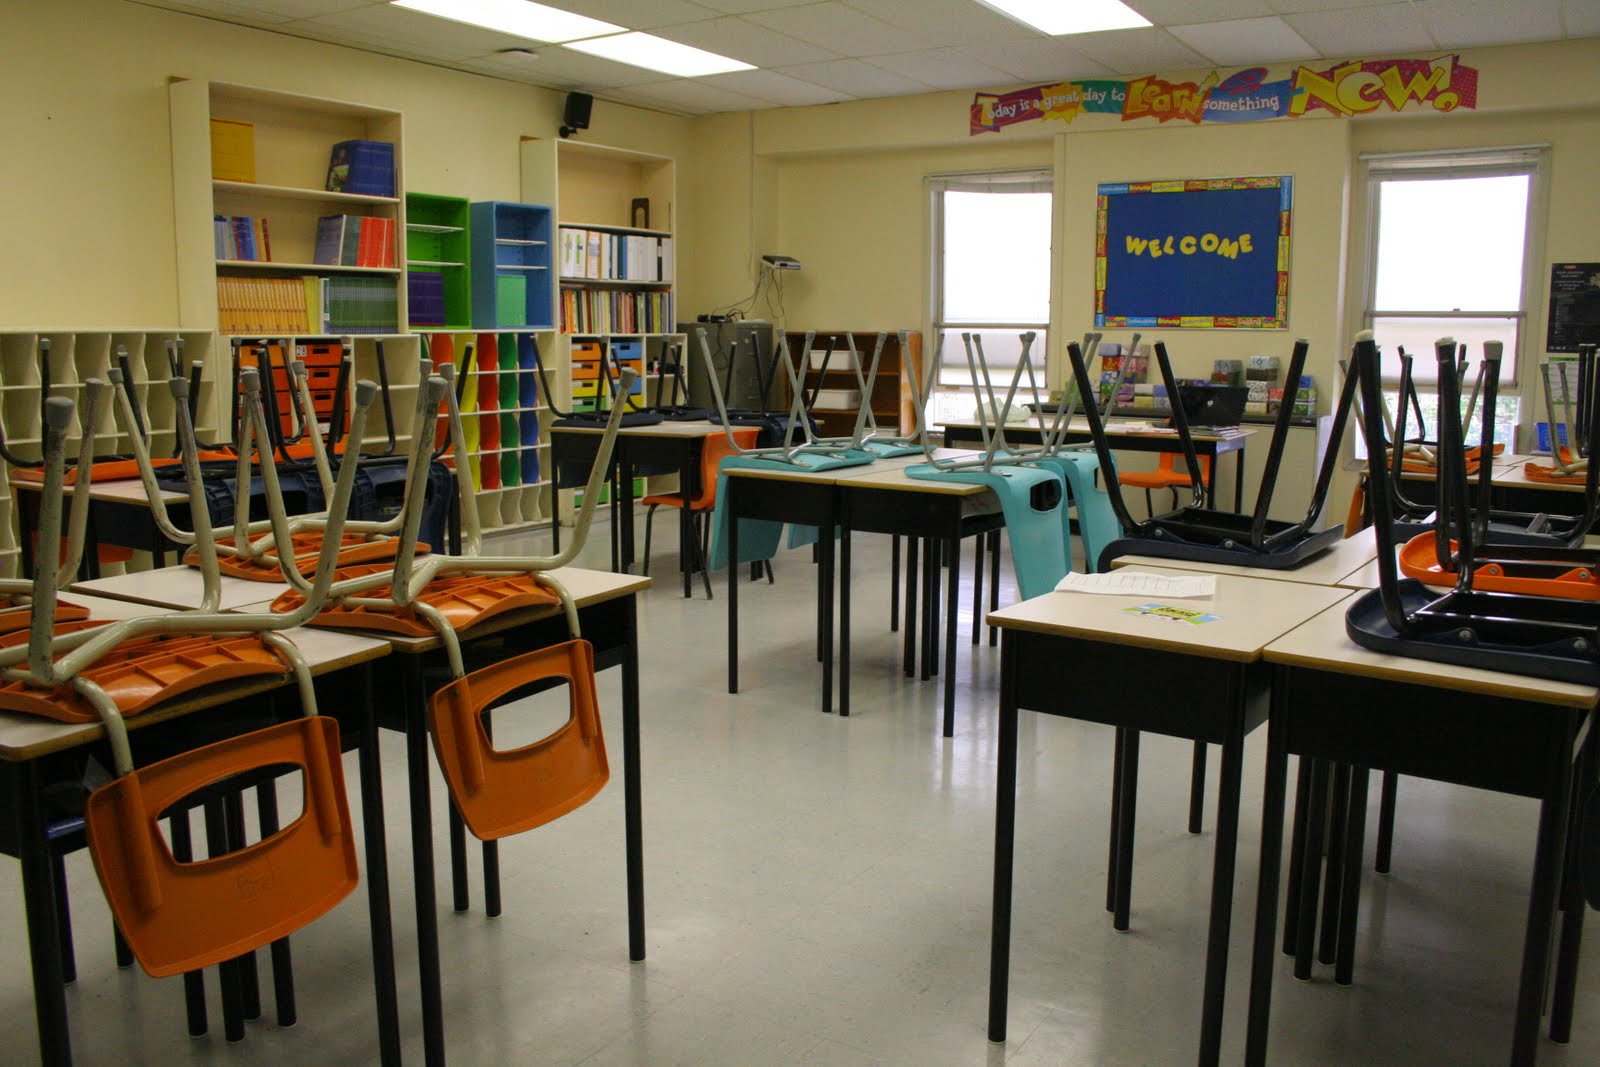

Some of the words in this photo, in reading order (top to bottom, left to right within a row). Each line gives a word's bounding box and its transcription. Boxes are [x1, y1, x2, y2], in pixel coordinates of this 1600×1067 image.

[977, 95, 1017, 127] Today
[1020, 99, 1029, 111] is
[1033, 100, 1040, 108] a
[1044, 90, 1079, 110] great
[1083, 88, 1107, 104] day
[1111, 88, 1126, 102] to
[1203, 96, 1280, 111] something
[1125, 233, 1253, 260] WELCOME
